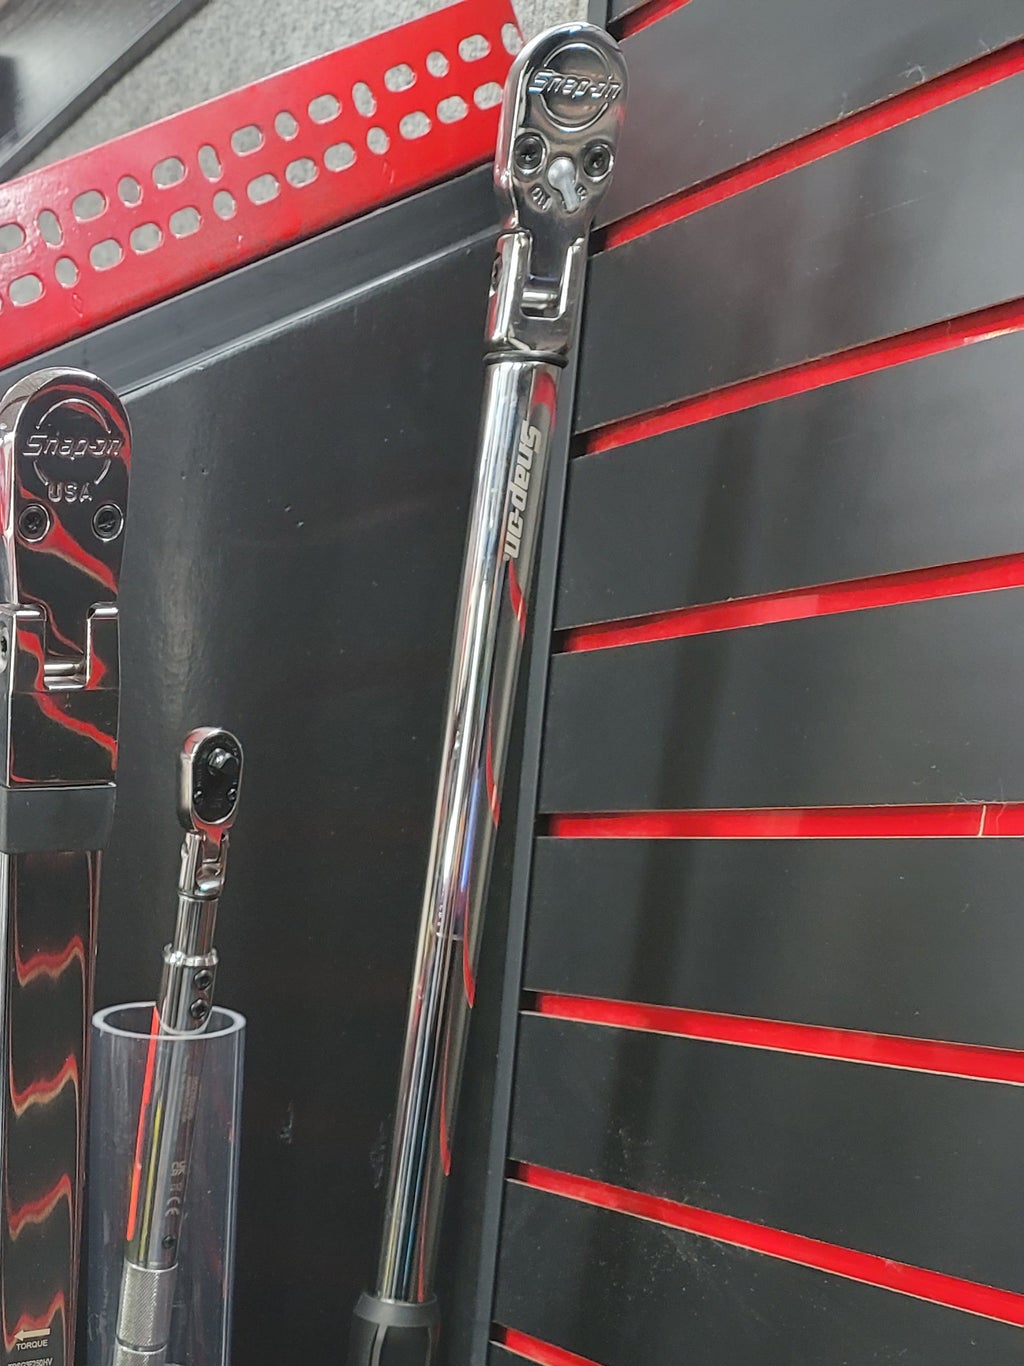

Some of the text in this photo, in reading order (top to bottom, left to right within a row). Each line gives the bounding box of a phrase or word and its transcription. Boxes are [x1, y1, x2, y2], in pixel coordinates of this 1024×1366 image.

[528, 70, 622, 101] Snap-on
[22, 434, 123, 461] Snap-on
[47, 482, 93, 503] USA
[502, 419, 542, 561] Snap-on
[16, 1339, 49, 1351] TORQUE
